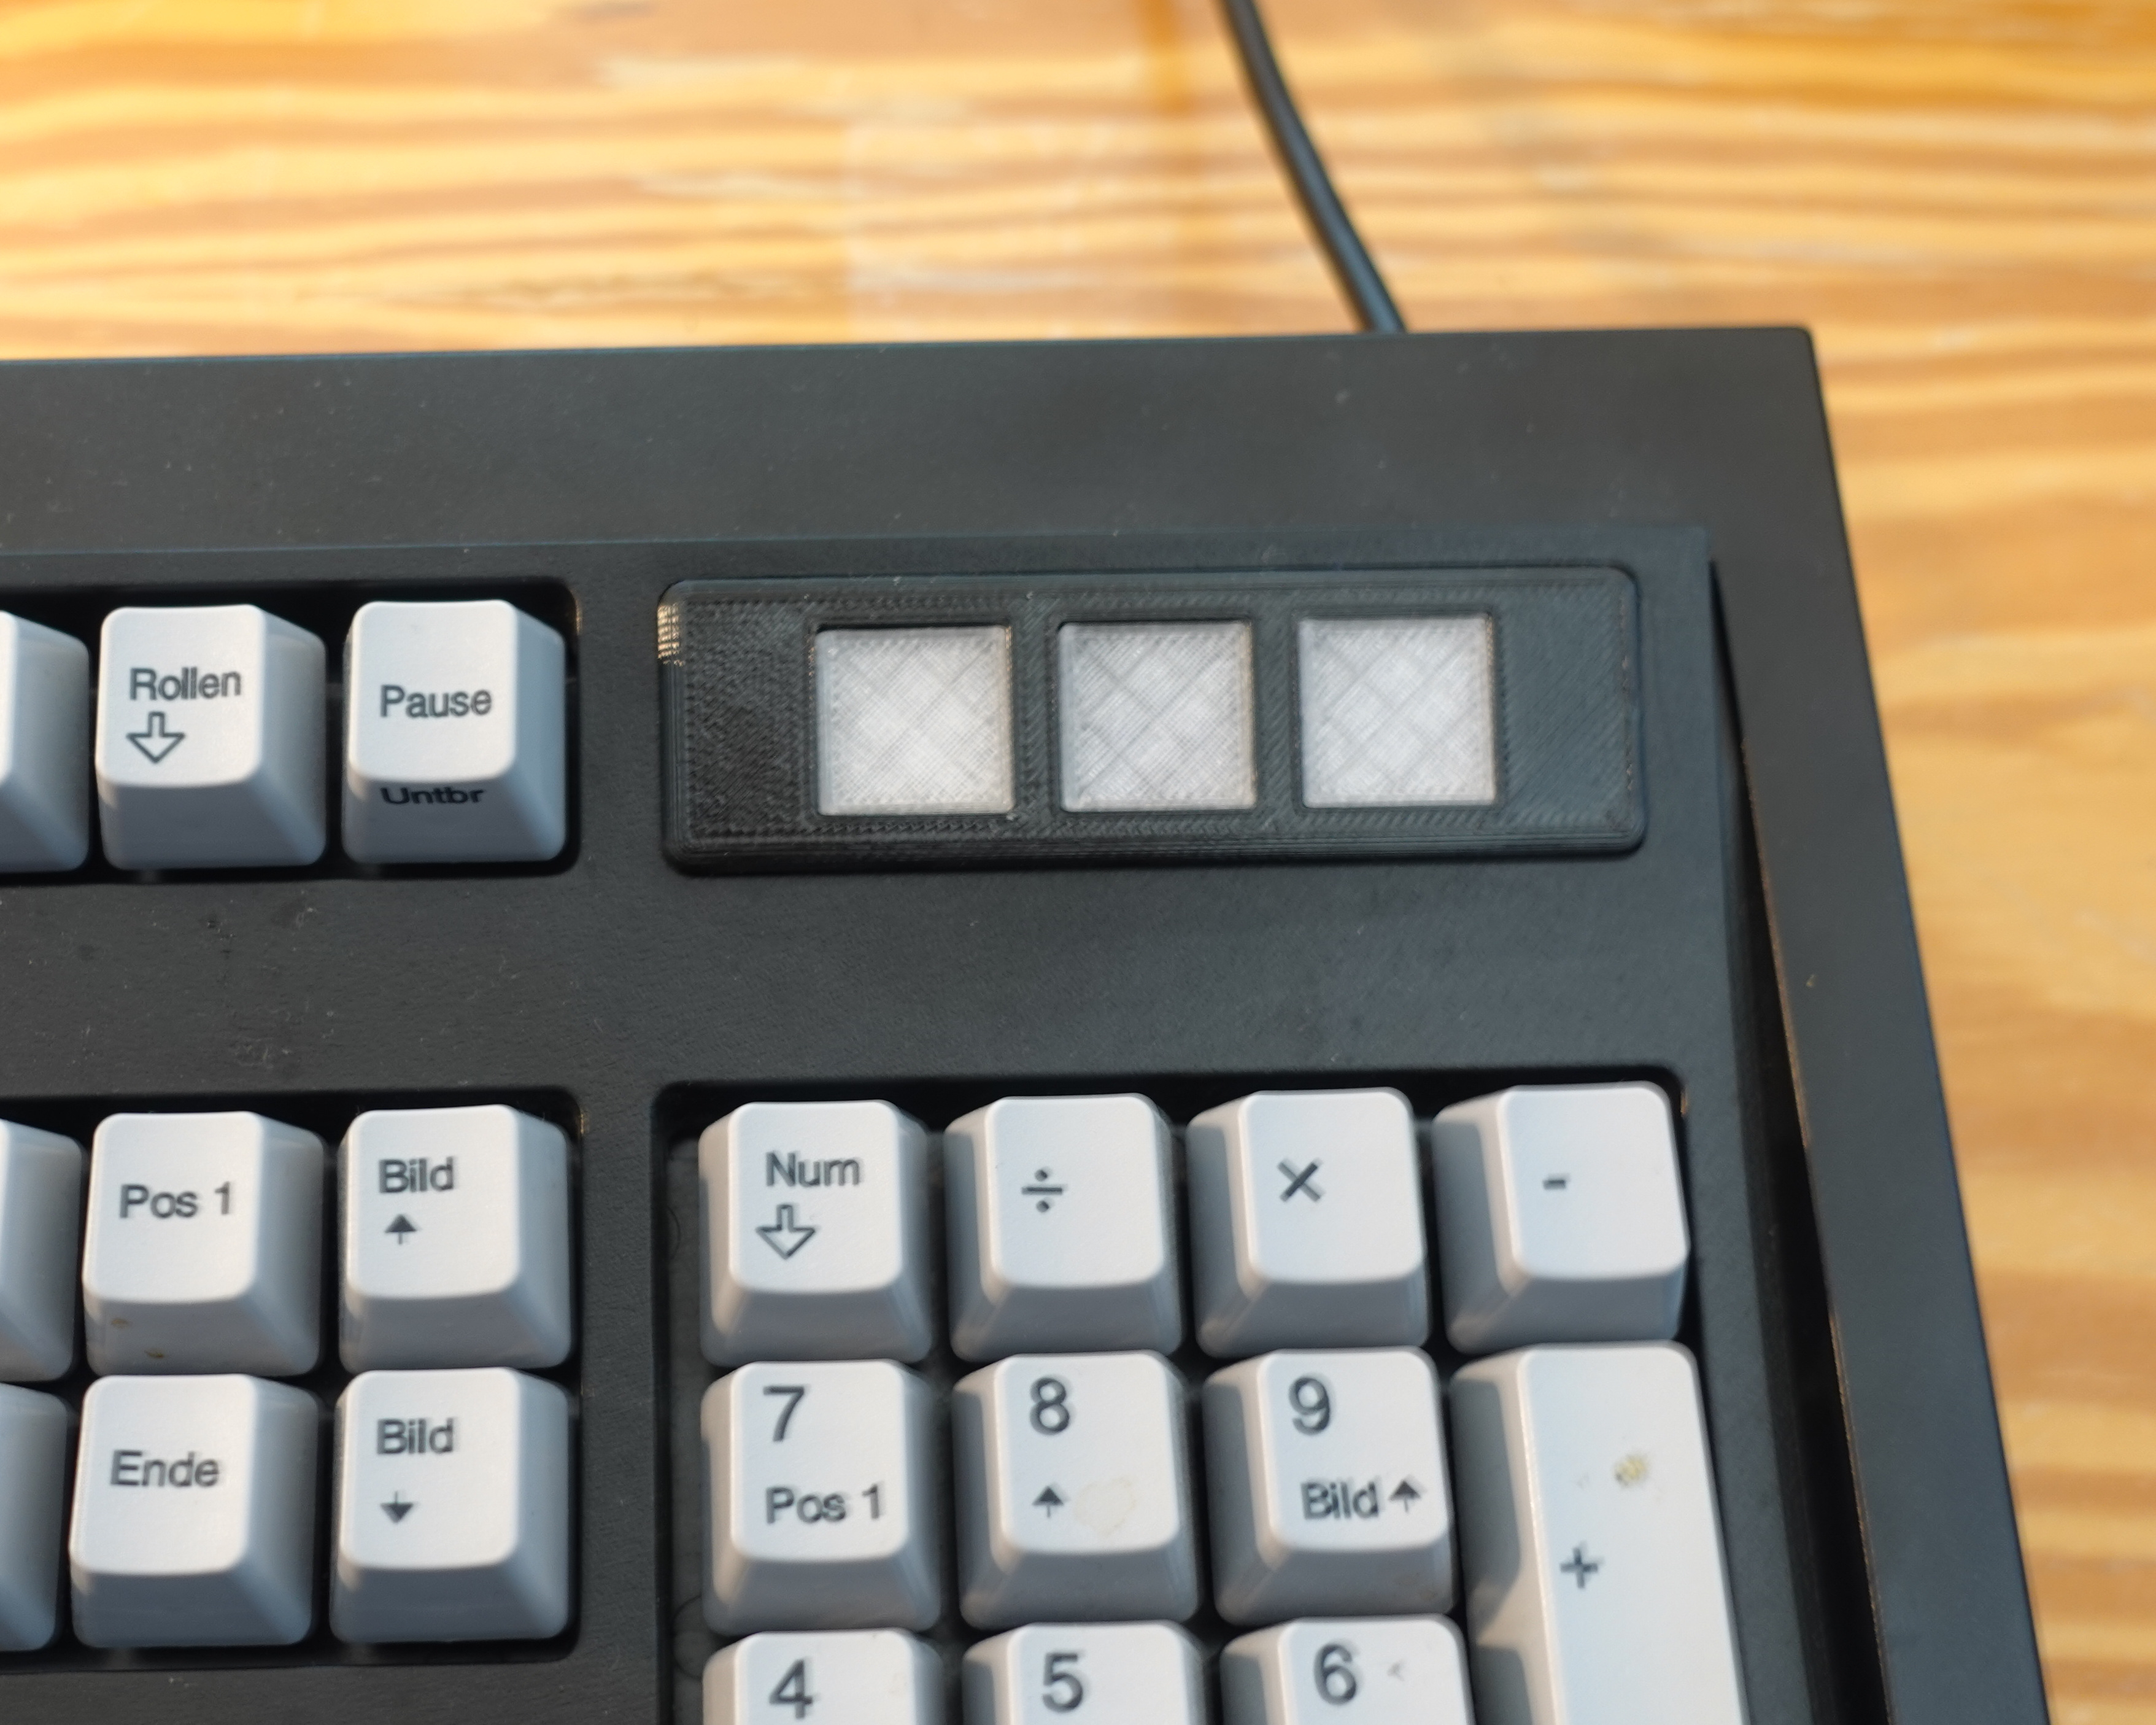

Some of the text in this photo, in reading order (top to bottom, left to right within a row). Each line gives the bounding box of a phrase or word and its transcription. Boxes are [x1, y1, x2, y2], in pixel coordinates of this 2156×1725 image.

[129, 667, 241, 701] Rollen
[381, 684, 492, 718] Pause
[380, 786, 484, 805] Untbr
[379, 1157, 455, 1193] Bild
[767, 1152, 860, 1187] Num
[120, 1182, 231, 1219] Pos 1
[763, 1386, 805, 1442] 7
[1030, 1377, 1071, 1435] 8
[1289, 1376, 1332, 1435] 9
[377, 1418, 454, 1455] Bild
[110, 1450, 220, 1488] Ende
[767, 1484, 881, 1524] Pos 1
[1302, 1481, 1380, 1519] Bild
[770, 1659, 817, 1720] 4
[1043, 1652, 1084, 1713] 5
[1314, 1643, 1358, 1705] 6
